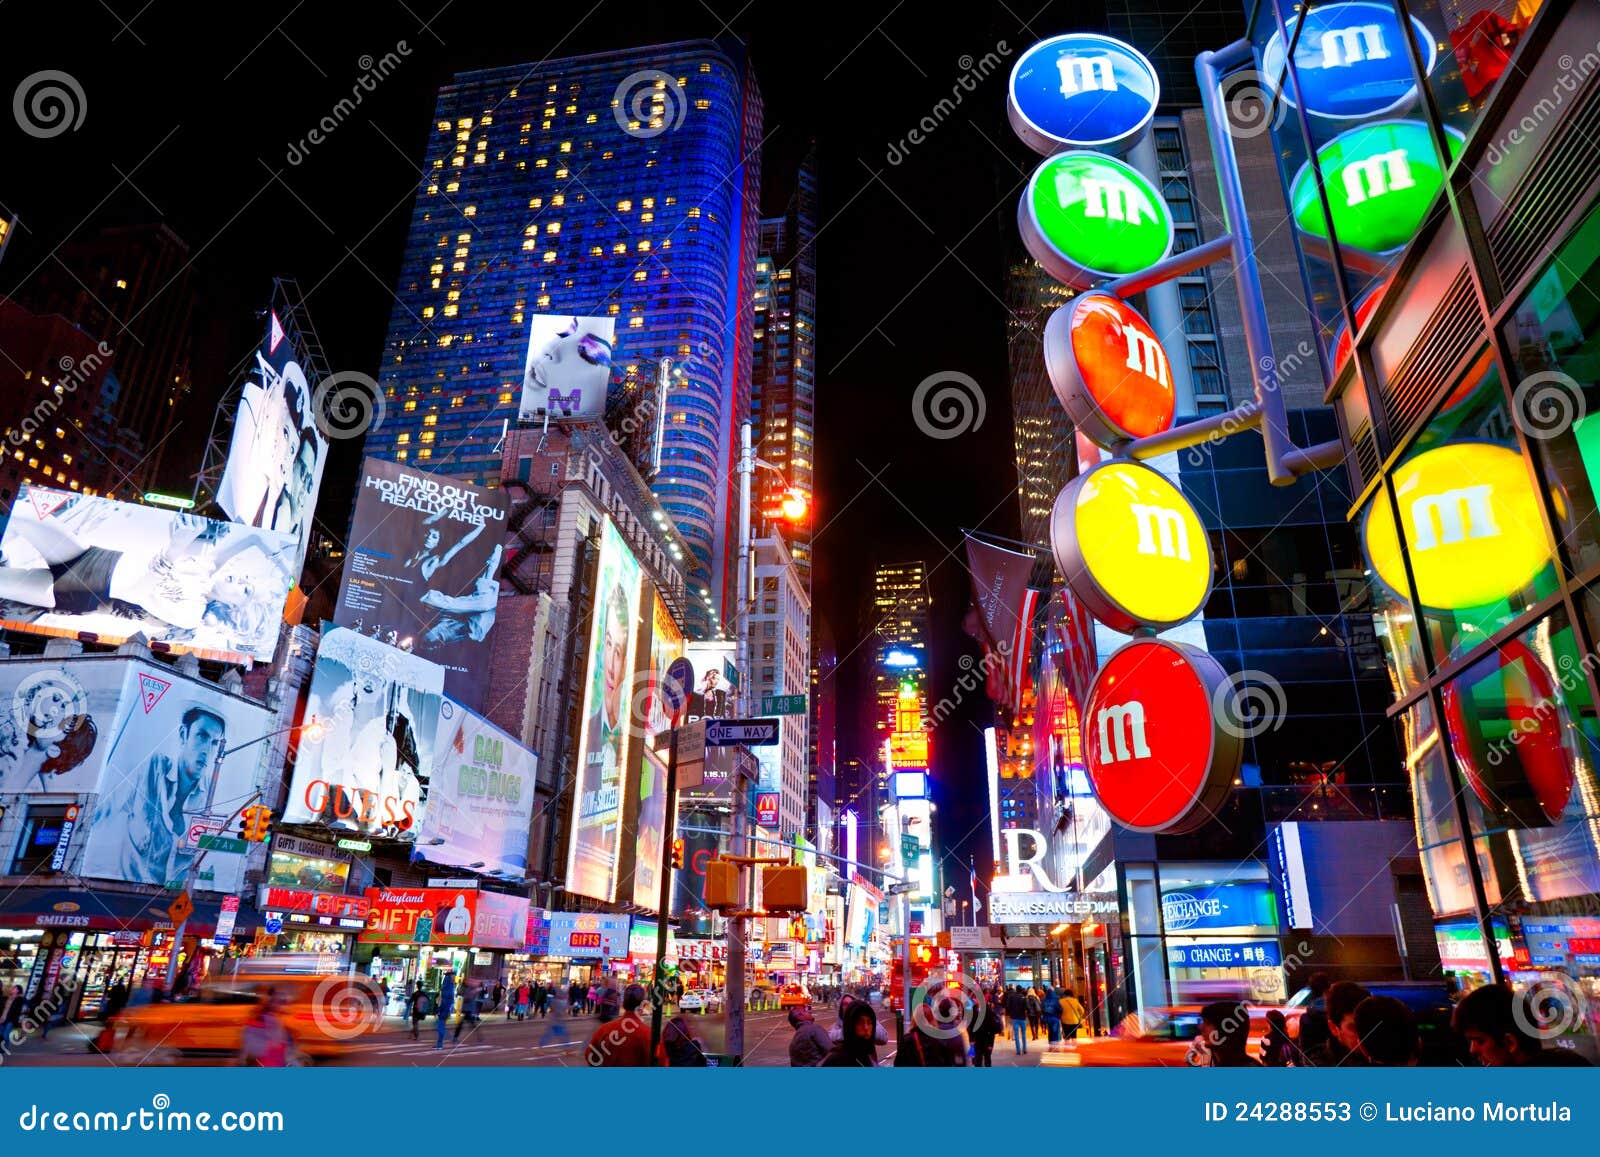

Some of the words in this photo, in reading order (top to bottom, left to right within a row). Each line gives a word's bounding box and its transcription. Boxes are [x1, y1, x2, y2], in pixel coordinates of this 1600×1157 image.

[399, 473, 440, 494] FIND
[443, 485, 479, 501] OUT
[31, 489, 68, 501] GUESS
[365, 476, 411, 497] HOW
[414, 486, 466, 511] GOOD
[471, 503, 505, 521] YOU
[381, 492, 449, 517] REALLY
[985, 574, 1004, 627] NAISSANCE
[143, 678, 164, 692] GUESS
[765, 700, 773, 713] W
[777, 699, 790, 712] 48
[709, 728, 733, 738] ONE
[743, 727, 769, 738] WAY
[304, 779, 415, 832] GUESS
[277, 836, 296, 850] GIFTS
[1001, 828, 1071, 893] R
[378, 891, 425, 904] Playland
[990, 901, 1083, 915] RENAISSANCE
[1168, 899, 1221, 920] EXCHANGE
[36, 915, 90, 926] SMILER'S
[571, 934, 600, 945] GIFTS
[1191, 948, 1232, 962] CHANGE
